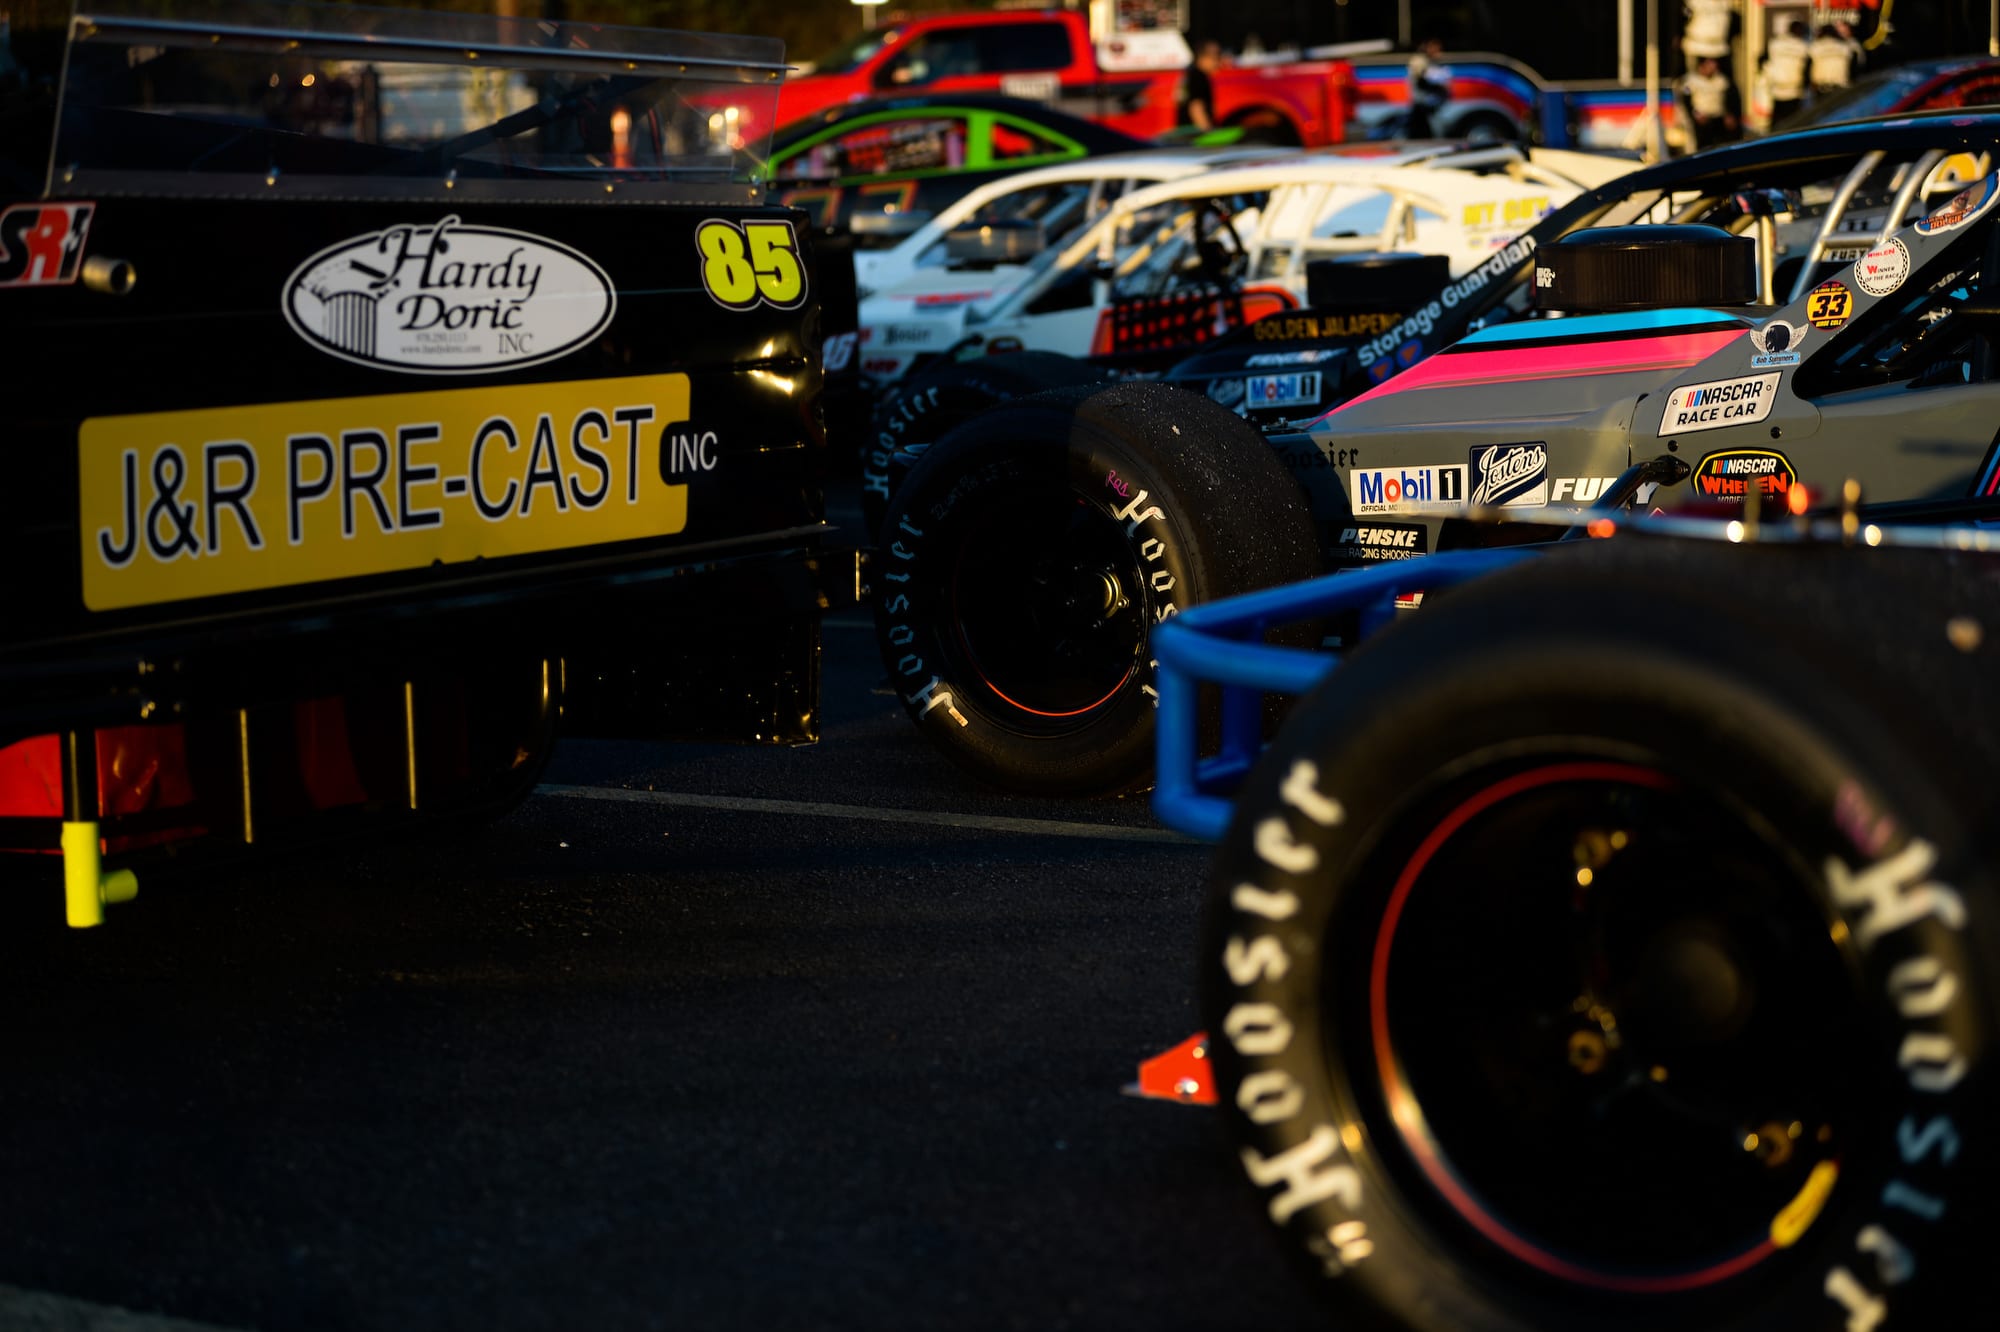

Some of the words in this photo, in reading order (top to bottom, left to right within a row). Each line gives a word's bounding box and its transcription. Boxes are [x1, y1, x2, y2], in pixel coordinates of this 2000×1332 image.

[379, 215, 542, 304] Hardy
[696, 220, 807, 310] 85
[1440, 234, 1538, 309] Guardian
[395, 294, 523, 330] Doric
[1812, 293, 1848, 318] 33
[498, 332, 534, 354] INC
[1252, 316, 1320, 341] GOLDEN
[1356, 300, 1443, 369] Storage
[1251, 375, 1297, 400] Mobil
[1699, 380, 1764, 406] NASCAR
[1677, 408, 1720, 425] RACE
[1723, 402, 1757, 418] CAR
[670, 431, 719, 475] INC
[1727, 458, 1778, 474] NASCAR
[98, 440, 267, 571] J&R
[285, 404, 657, 547] PRE-CAST
[1359, 469, 1432, 505] Mobil
[1472, 445, 1546, 506] Jostens
[1360, 503, 1387, 513] OFFICIAL
[1339, 528, 1419, 548] PENSKE
[1348, 547, 1380, 560] RACING
[1380, 549, 1411, 560] SHOCKS
[884, 514, 954, 721] Hoosier
[1220, 757, 1364, 1227] Hoosier
